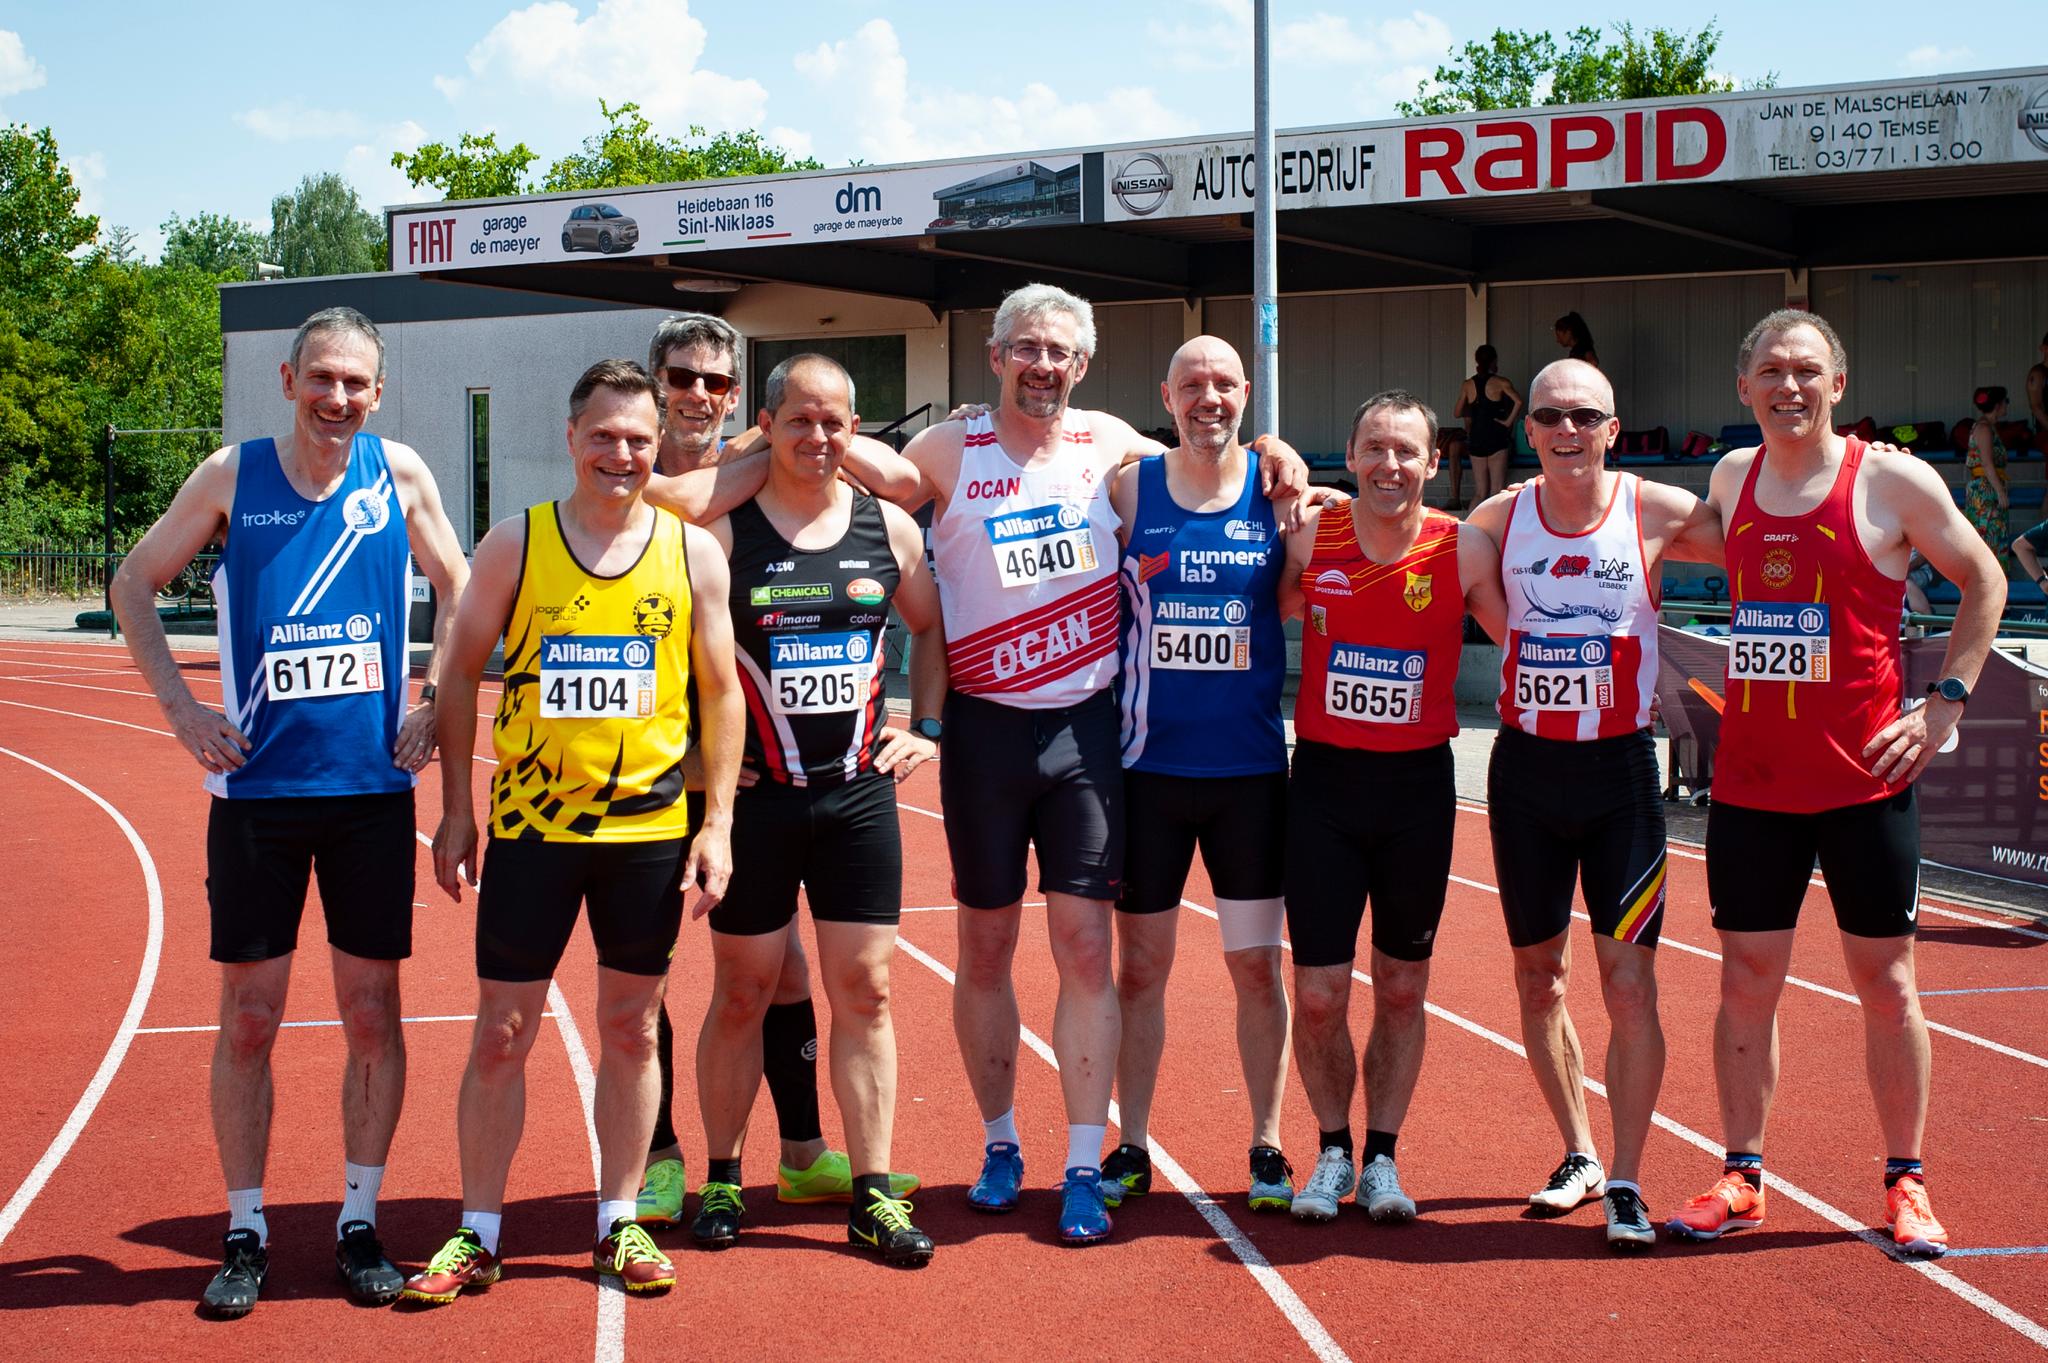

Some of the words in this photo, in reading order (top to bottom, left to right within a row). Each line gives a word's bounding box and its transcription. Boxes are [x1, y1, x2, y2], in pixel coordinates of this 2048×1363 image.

[1978, 86, 1992, 104] 7
[1809, 122, 1873, 144] 9140
[1117, 177, 1168, 190] NISSAN
[1193, 145, 1376, 201] AUTOEDRIJF
[677, 196, 751, 215] Heidebaan
[754, 192, 774, 209] 116
[835, 181, 882, 215] dm
[482, 214, 527, 236] garage
[678, 211, 775, 235] Sint-Niklaas
[813, 220, 843, 234] garage
[844, 218, 857, 229] de
[857, 215, 903, 230] maeyer.be
[408, 218, 457, 265] FIAT
[470, 238, 487, 255] de
[489, 237, 541, 257] maeyer
[966, 477, 1021, 500] OCAN
[994, 514, 1056, 539] Allianz
[1144, 526, 1168, 535] CRAFT
[1236, 520, 1266, 531] ACHL
[1763, 534, 1791, 542] CRAFT
[1006, 539, 1075, 579] 4640
[1180, 565, 1216, 582] lab
[771, 586, 830, 598] CHEMICALS
[1314, 586, 1353, 596] SPORTARENA
[1598, 581, 1628, 591] LEBBEKE
[534, 605, 578, 615] jogging
[1156, 601, 1220, 620] Allianz
[1736, 608, 1795, 628] Allianz
[270, 622, 344, 645] Allianz
[992, 608, 1092, 680] OCAN
[546, 643, 620, 663] Allianz
[777, 642, 845, 662] Allianz
[1157, 632, 1231, 665] 5400
[1519, 642, 1577, 662] Allianz
[1735, 641, 1807, 676] 5528
[273, 652, 358, 693] 6172
[1333, 649, 1399, 674] Allianz
[1815, 656, 1825, 679] 2023
[546, 676, 628, 711] 4104
[780, 673, 855, 708] 5205
[1332, 680, 1408, 718] 5655
[1518, 673, 1588, 705] 5621
[1599, 685, 1608, 706] 2023
